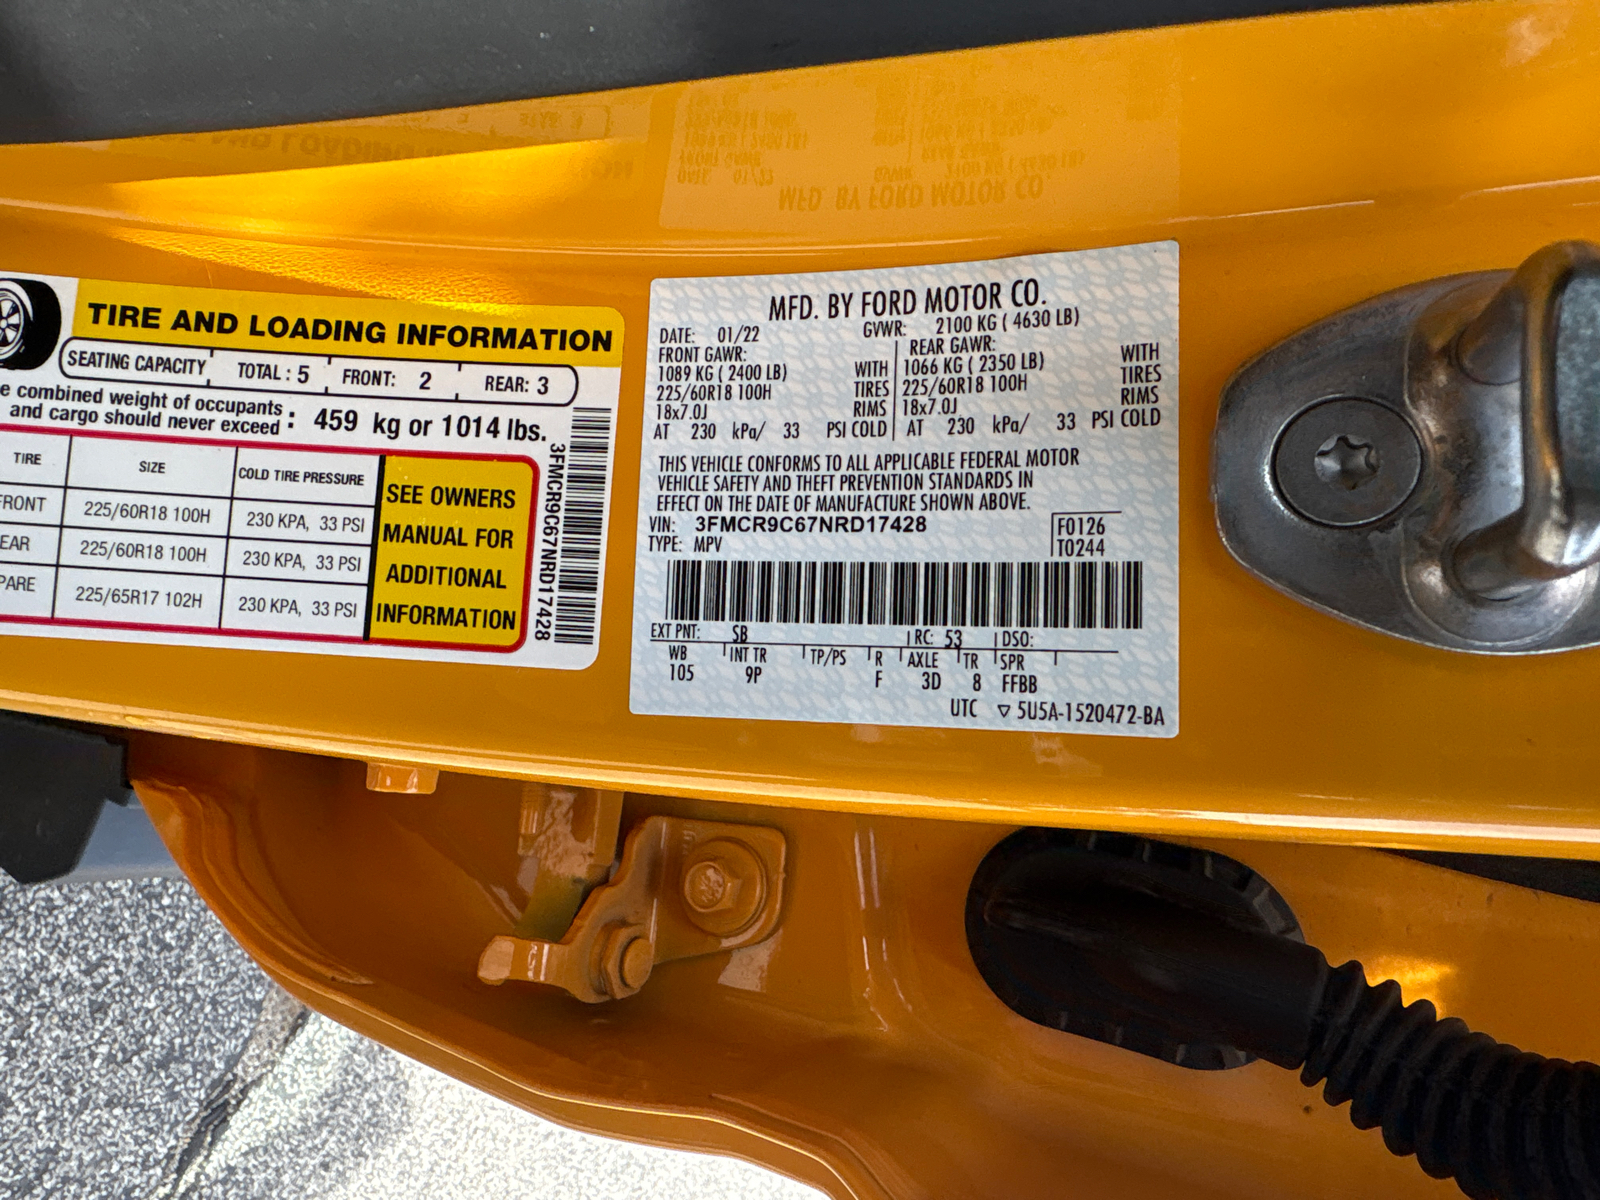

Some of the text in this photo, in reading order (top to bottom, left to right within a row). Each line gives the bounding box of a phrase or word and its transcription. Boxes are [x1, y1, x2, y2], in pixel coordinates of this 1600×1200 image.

[769, 278, 1046, 321] MFD. BY FORD MOTOR CO.
[88, 302, 612, 352] TIRE AND LOADING INFORMATION
[863, 321, 906, 338] GVWR:
[936, 316, 972, 335] 2100
[978, 314, 996, 331] KG
[1056, 307, 1079, 327] LB)
[660, 325, 759, 344] DATE: 01/22
[659, 346, 747, 363] FRONT GAWR:
[910, 337, 995, 355] REAR GAWR:
[1121, 342, 1159, 362] WITH
[68, 350, 206, 376] SEATING CAPACITY
[658, 365, 690, 382] 1089
[696, 365, 713, 381] KG
[767, 363, 787, 382] LB)
[855, 361, 888, 377] WITH
[904, 358, 938, 375] 1066
[944, 357, 962, 373] KG
[1021, 351, 1044, 371] LB)
[297, 365, 310, 384] 5
[343, 369, 432, 390] FRONT: 2
[1121, 365, 1161, 384] TIRES
[485, 376, 549, 395] REAR: 3
[657, 383, 771, 402] 225/60R18 100H
[854, 381, 889, 397] TIRES
[902, 374, 1027, 397] 225/60R18 100H
[17, 384, 103, 404] combined
[110, 391, 168, 413] weight
[174, 394, 190, 410] of
[195, 396, 282, 418] occupants
[1121, 386, 1159, 405] RIMS
[657, 404, 707, 420] 18x7.0J
[854, 400, 886, 417] RIMS
[903, 398, 957, 416] 18x7.0J
[10, 404, 280, 435] and cargo should never exceed
[314, 408, 547, 442] 459 kg or 1014 lbs.
[907, 408, 1160, 436] AT 230 kPa/ 33 PSI COLD
[654, 421, 887, 442] AT 230 kPa/ 33 PSI COLD
[14, 452, 41, 466] TIRE
[139, 461, 166, 474] SIZE
[659, 448, 1079, 472] THIS VEHICLE CONFORMS TO ALL APPLICABLE FEDERAL MOTOR
[239, 467, 364, 485] COLD TIRE PRESSURE
[658, 470, 1033, 492] VEHICLE SAFETY AND THEFT PREVENTION STANDARDS IN
[0, 494, 46, 512] RONT
[386, 484, 516, 509] SEE OWNERS
[657, 492, 1030, 512] EFFECT ON THE DATE OF MANUFACTURE SHOWN ABOVE.
[84, 500, 210, 524] 225/60R18 100H
[247, 512, 364, 532] 230 KPA, 33 PSI
[649, 516, 927, 533] VIN: 3FMCR9C67NRD17428
[1057, 517, 1105, 535] F0126
[0, 534, 30, 551] EAR
[383, 524, 513, 549] MANUAL FOR
[535, 443, 566, 641] 3FMCR9C67NRD17428
[648, 535, 722, 552] TYPE: MPV
[80, 540, 206, 562] 225/60R18 100H
[1057, 538, 1105, 557] T0244
[243, 551, 361, 572] 230 KPA, 33 PSI
[0, 574, 36, 592] PARE
[386, 563, 507, 589] ADDITIONAL
[76, 586, 202, 608] 225/65R17 102H
[239, 597, 357, 618] 230 KPA, 33 PSI
[376, 603, 516, 630] INFORMATION
[651, 623, 700, 639] EXT PNT:
[915, 630, 934, 645] RC:
[1002, 631, 1033, 647] DSO:
[669, 645, 687, 660] WB
[730, 646, 767, 663] INT TR
[811, 648, 846, 667] TP/PS
[908, 652, 938, 668] AXLE
[1000, 654, 1025, 671] SPR
[670, 664, 694, 681] 105
[1002, 675, 1037, 693] FFBB
[950, 698, 1164, 725] UTC 5U5A-1520472-BA
